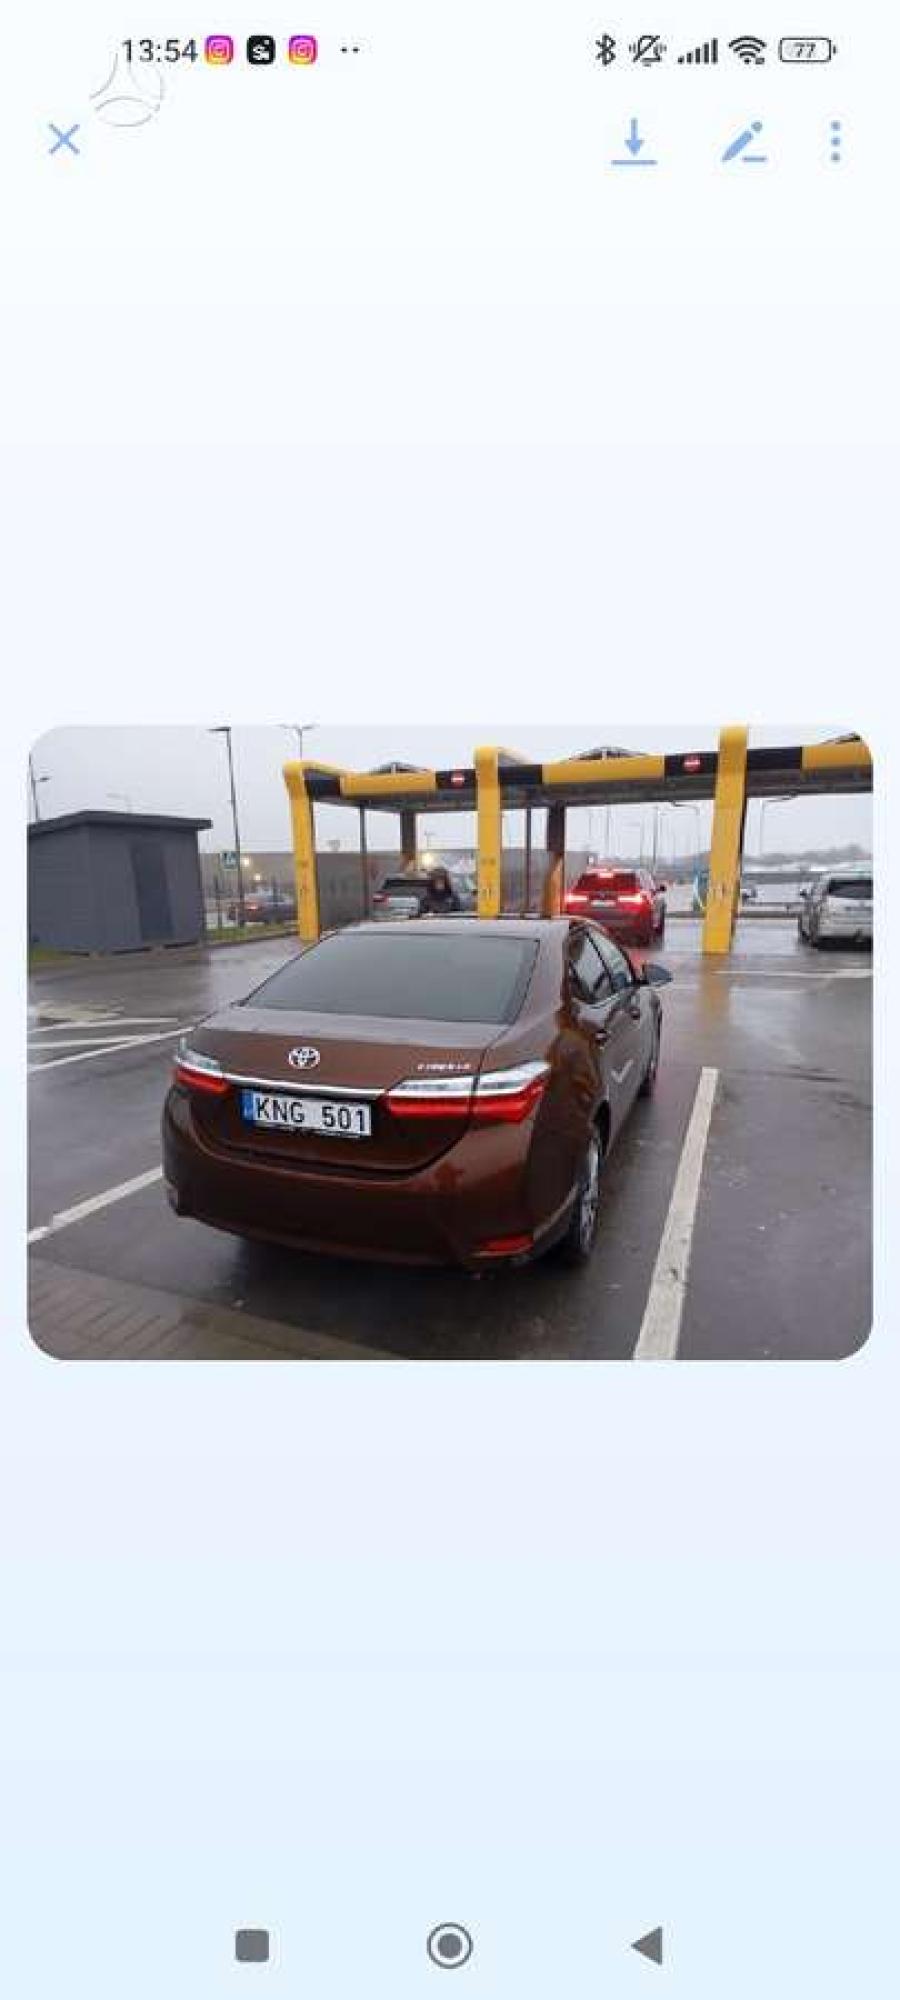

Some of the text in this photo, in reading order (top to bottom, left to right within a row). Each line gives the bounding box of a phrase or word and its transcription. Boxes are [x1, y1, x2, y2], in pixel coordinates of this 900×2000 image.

[123, 39, 198, 62] 13:54
[794, 42, 816, 58] 77
[256, 1097, 366, 1132] KNG 501
